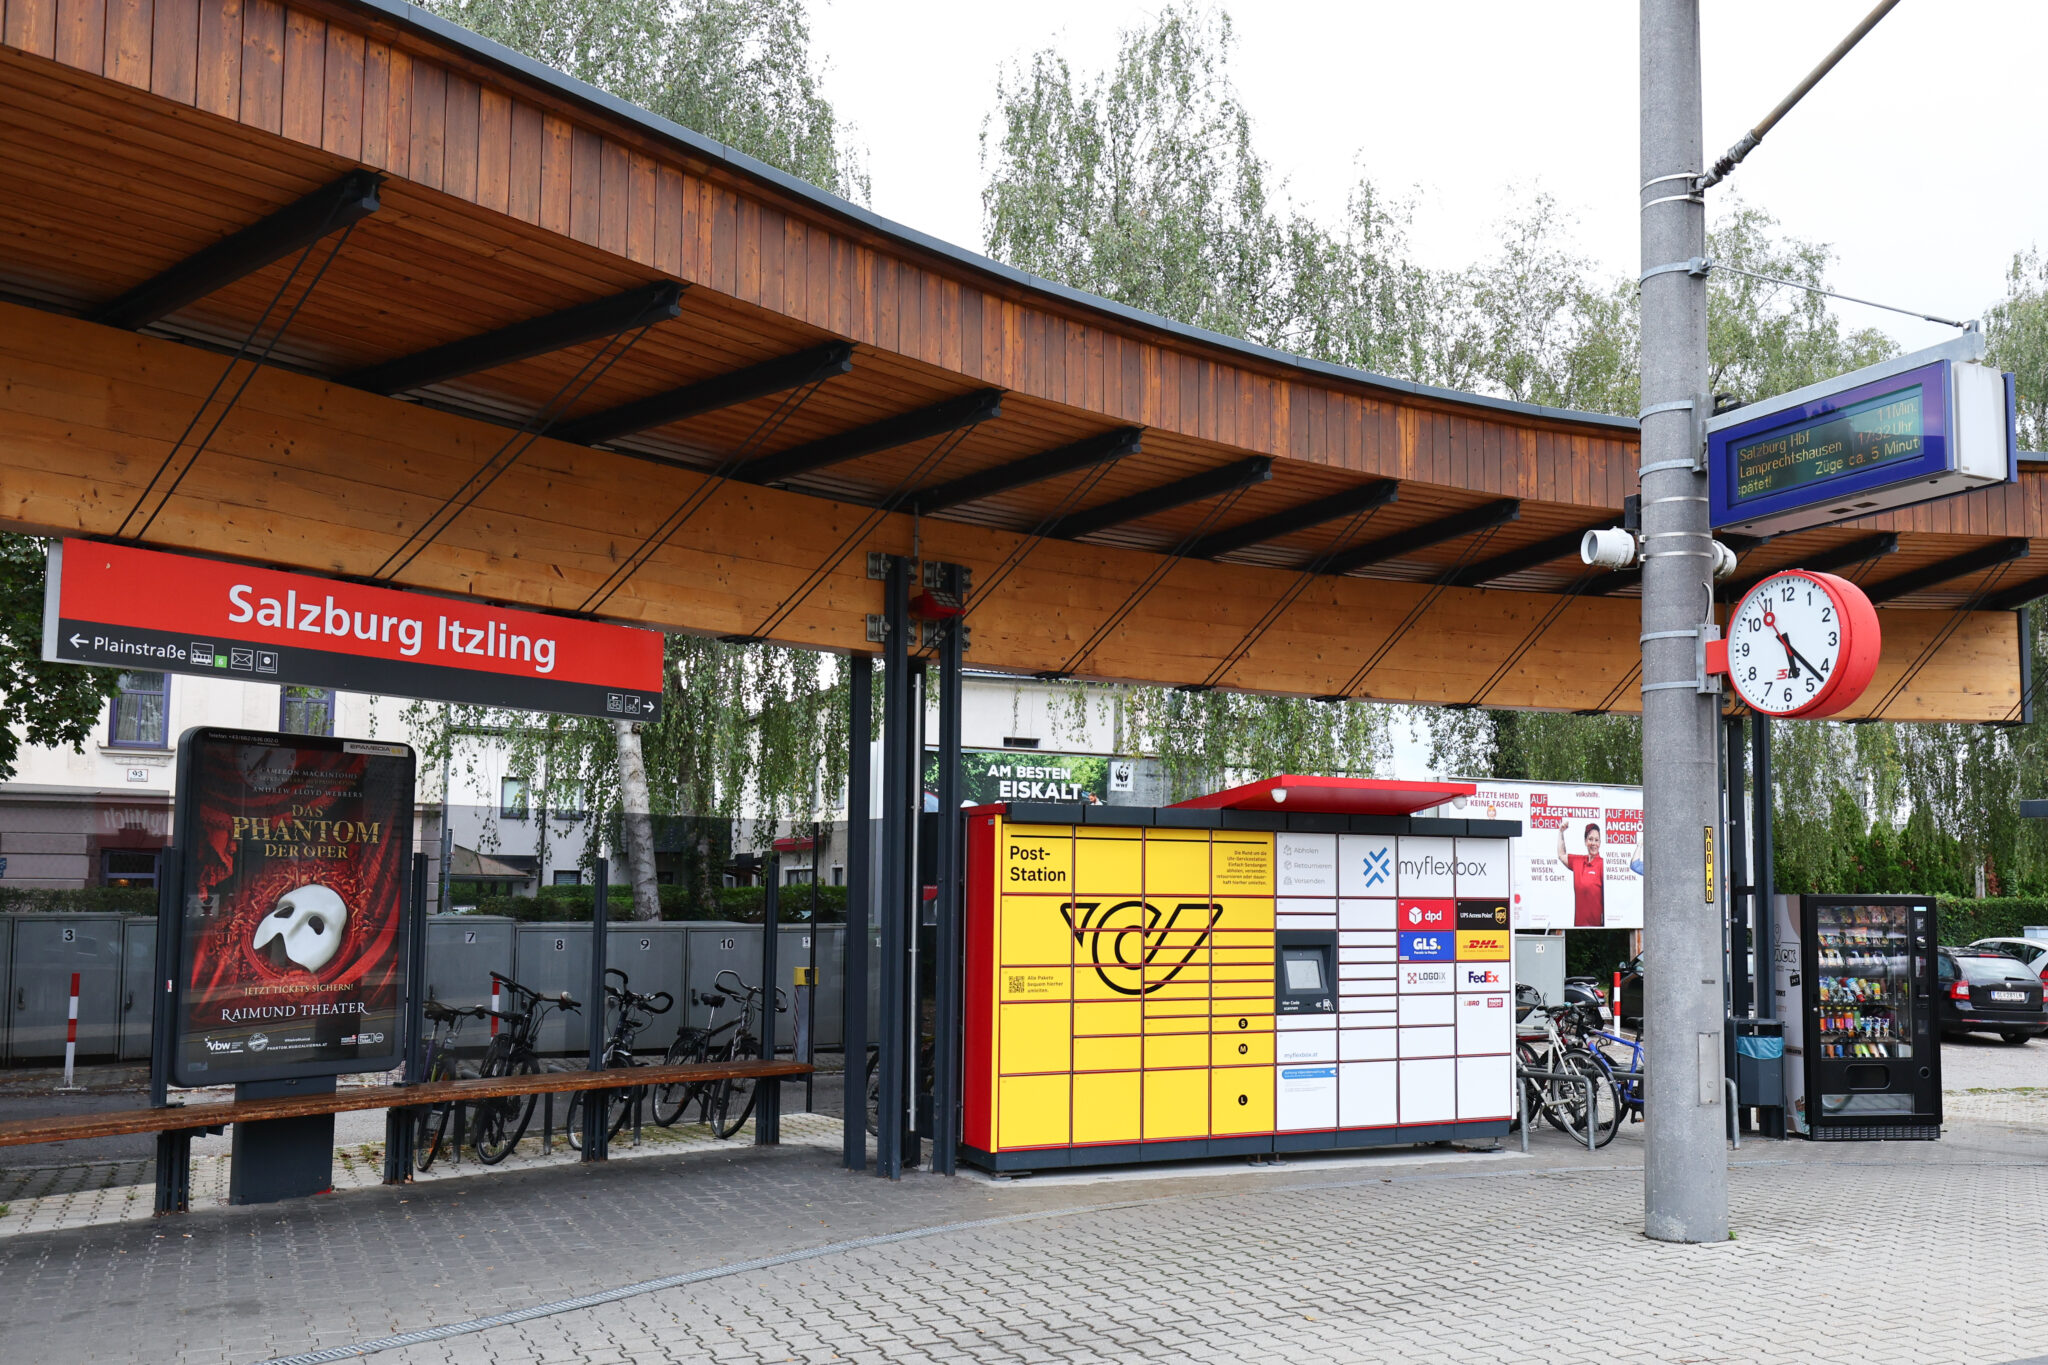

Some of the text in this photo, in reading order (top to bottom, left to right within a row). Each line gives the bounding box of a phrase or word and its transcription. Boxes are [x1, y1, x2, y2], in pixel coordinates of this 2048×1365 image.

[1740, 432, 1810, 462] Salzburg Hbf
[1740, 442, 1842, 478] Lamprechtshausen
[1815, 459, 1843, 475] Züge
[1849, 453, 1866, 466] ca.
[1871, 446, 1880, 459] 5
[1781, 586, 1795, 602] 12
[1806, 591, 1812, 606] 1
[1763, 597, 1773, 612] 11
[1821, 607, 1831, 622] 2
[229, 584, 556, 673] Salzburg Itzling
[1748, 617, 1762, 632] 10
[1828, 631, 1838, 646] 3
[94, 636, 187, 660] Plainstraße
[1741, 642, 1750, 657] 9
[1748, 666, 1757, 680] 8
[1820, 658, 1830, 673] 4
[1764, 681, 1773, 697] 7
[1805, 677, 1815, 692] 5
[1783, 687, 1793, 702] 6
[349, 743, 390, 752] EPAMEDIA
[987, 764, 1071, 780] AM BESTEN
[252, 784, 363, 798] ANDREW LLOYD WEBBERS
[1000, 780, 1082, 800] EISKALT
[1499, 792, 1520, 800] HEMD
[1470, 799, 1490, 807] KEINE
[1531, 794, 1547, 805] AUF
[291, 803, 324, 818] DAS
[1606, 809, 1622, 820] AUF
[231, 816, 382, 844] PHANTOM
[1531, 817, 1562, 829] HÖREN
[1606, 831, 1636, 844] HÖREN
[264, 843, 348, 859] DER OPER
[1010, 845, 1051, 861] Post-
[1293, 847, 1319, 855] Abholen
[1010, 866, 1066, 882] Station
[1399, 856, 1487, 880] myflexbox
[1424, 910, 1443, 923] dpd
[1496, 911, 1506, 922] ups
[64, 929, 74, 942] 3
[466, 932, 476, 943] 7
[556, 939, 564, 950] 8
[640, 939, 650, 950] 9
[720, 938, 734, 949] 10
[1468, 939, 1499, 949] DHL
[1468, 970, 1499, 984] FedEx
[244, 983, 354, 996] JETZT TICKETS SICHERN!
[221, 1002, 372, 1023] RAIMUND THEATER
[1240, 1020, 1246, 1028] S
[209, 1040, 231, 1051] vbw
[1239, 1045, 1247, 1053] M
